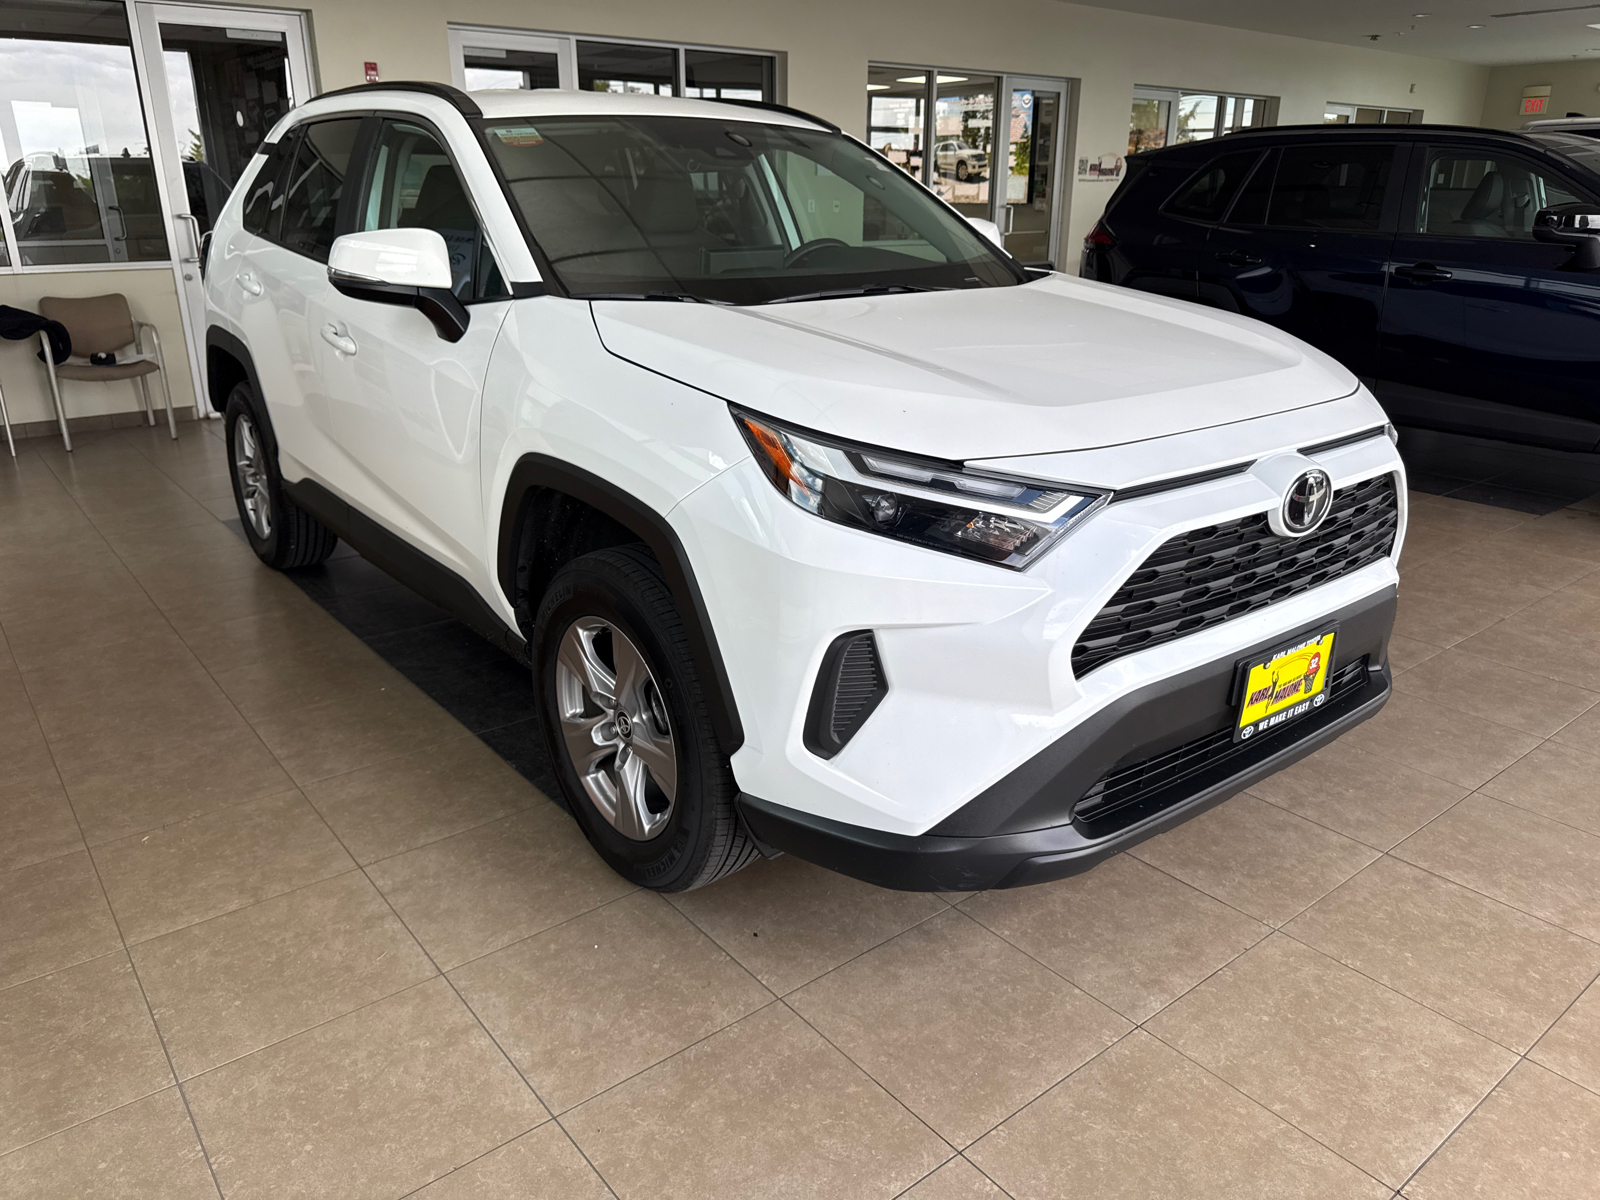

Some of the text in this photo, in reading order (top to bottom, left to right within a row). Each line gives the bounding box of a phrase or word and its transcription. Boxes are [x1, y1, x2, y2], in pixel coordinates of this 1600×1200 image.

[1524, 98, 1544, 113] EXIT
[1309, 657, 1319, 670] 32
[1246, 685, 1273, 708] KARL
[1270, 677, 1304, 706] MALONE
[1258, 701, 1310, 731] WE MAKE IT EASY
